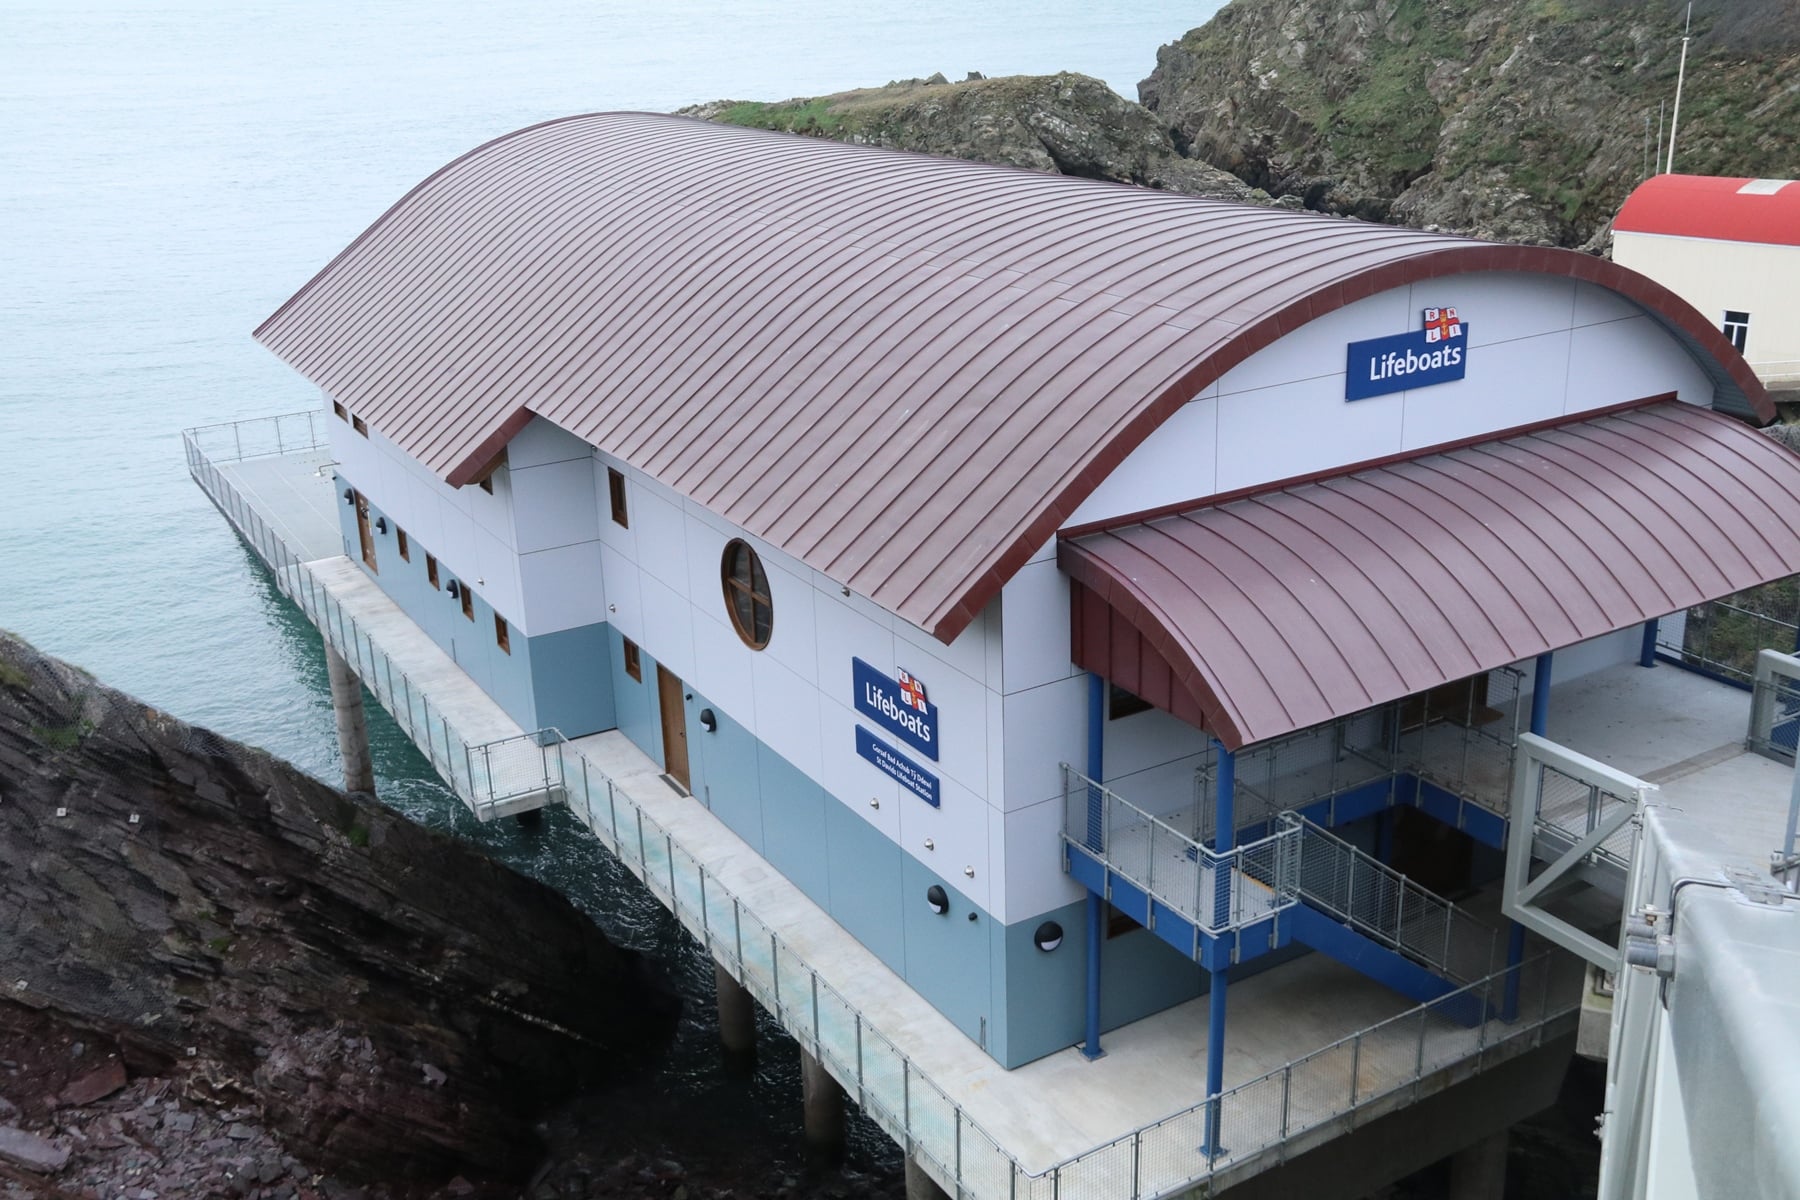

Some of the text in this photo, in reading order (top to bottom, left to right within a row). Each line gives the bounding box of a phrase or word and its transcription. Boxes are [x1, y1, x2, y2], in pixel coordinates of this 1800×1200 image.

[1370, 345, 1461, 381] Lifeboats
[866, 681, 931, 743] Lifeboats
[876, 756, 932, 800] St Davids Lifeboat Station
[887, 753, 896, 765] Bad
